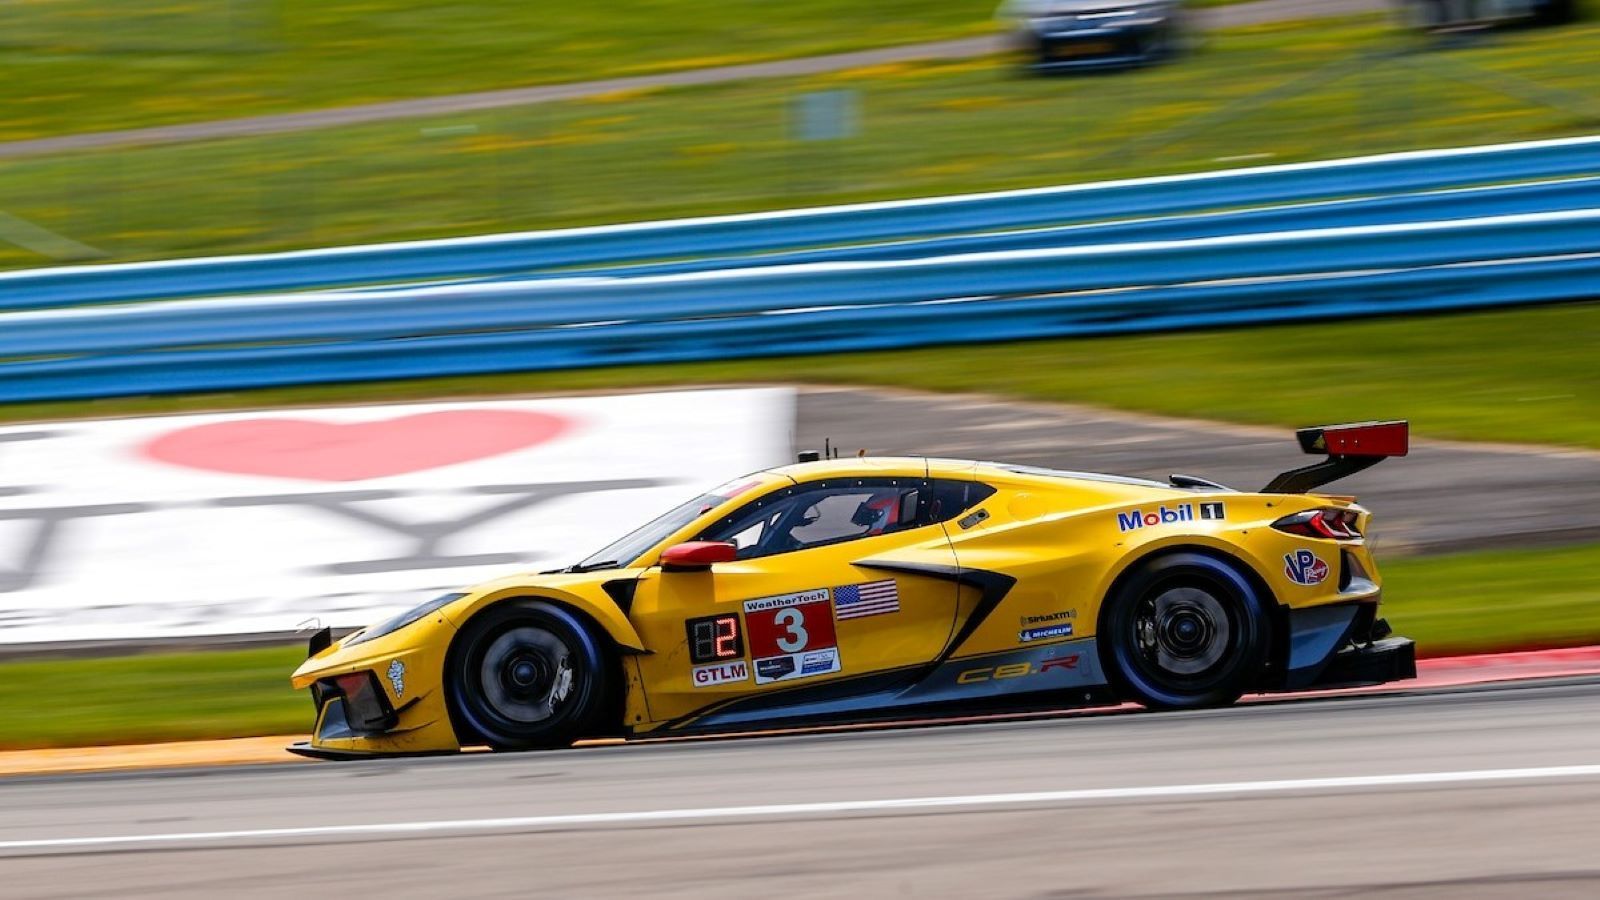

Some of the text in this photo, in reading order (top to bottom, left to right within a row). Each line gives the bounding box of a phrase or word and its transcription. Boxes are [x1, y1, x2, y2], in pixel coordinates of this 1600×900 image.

[1117, 503, 1219, 532] Mobil 1
[1284, 550, 1315, 584] VP
[747, 591, 826, 610] WeatherTech
[716, 617, 736, 657] 2
[774, 607, 808, 653] 3
[1032, 627, 1072, 638] MICHELIN
[695, 663, 746, 683] GTLM
